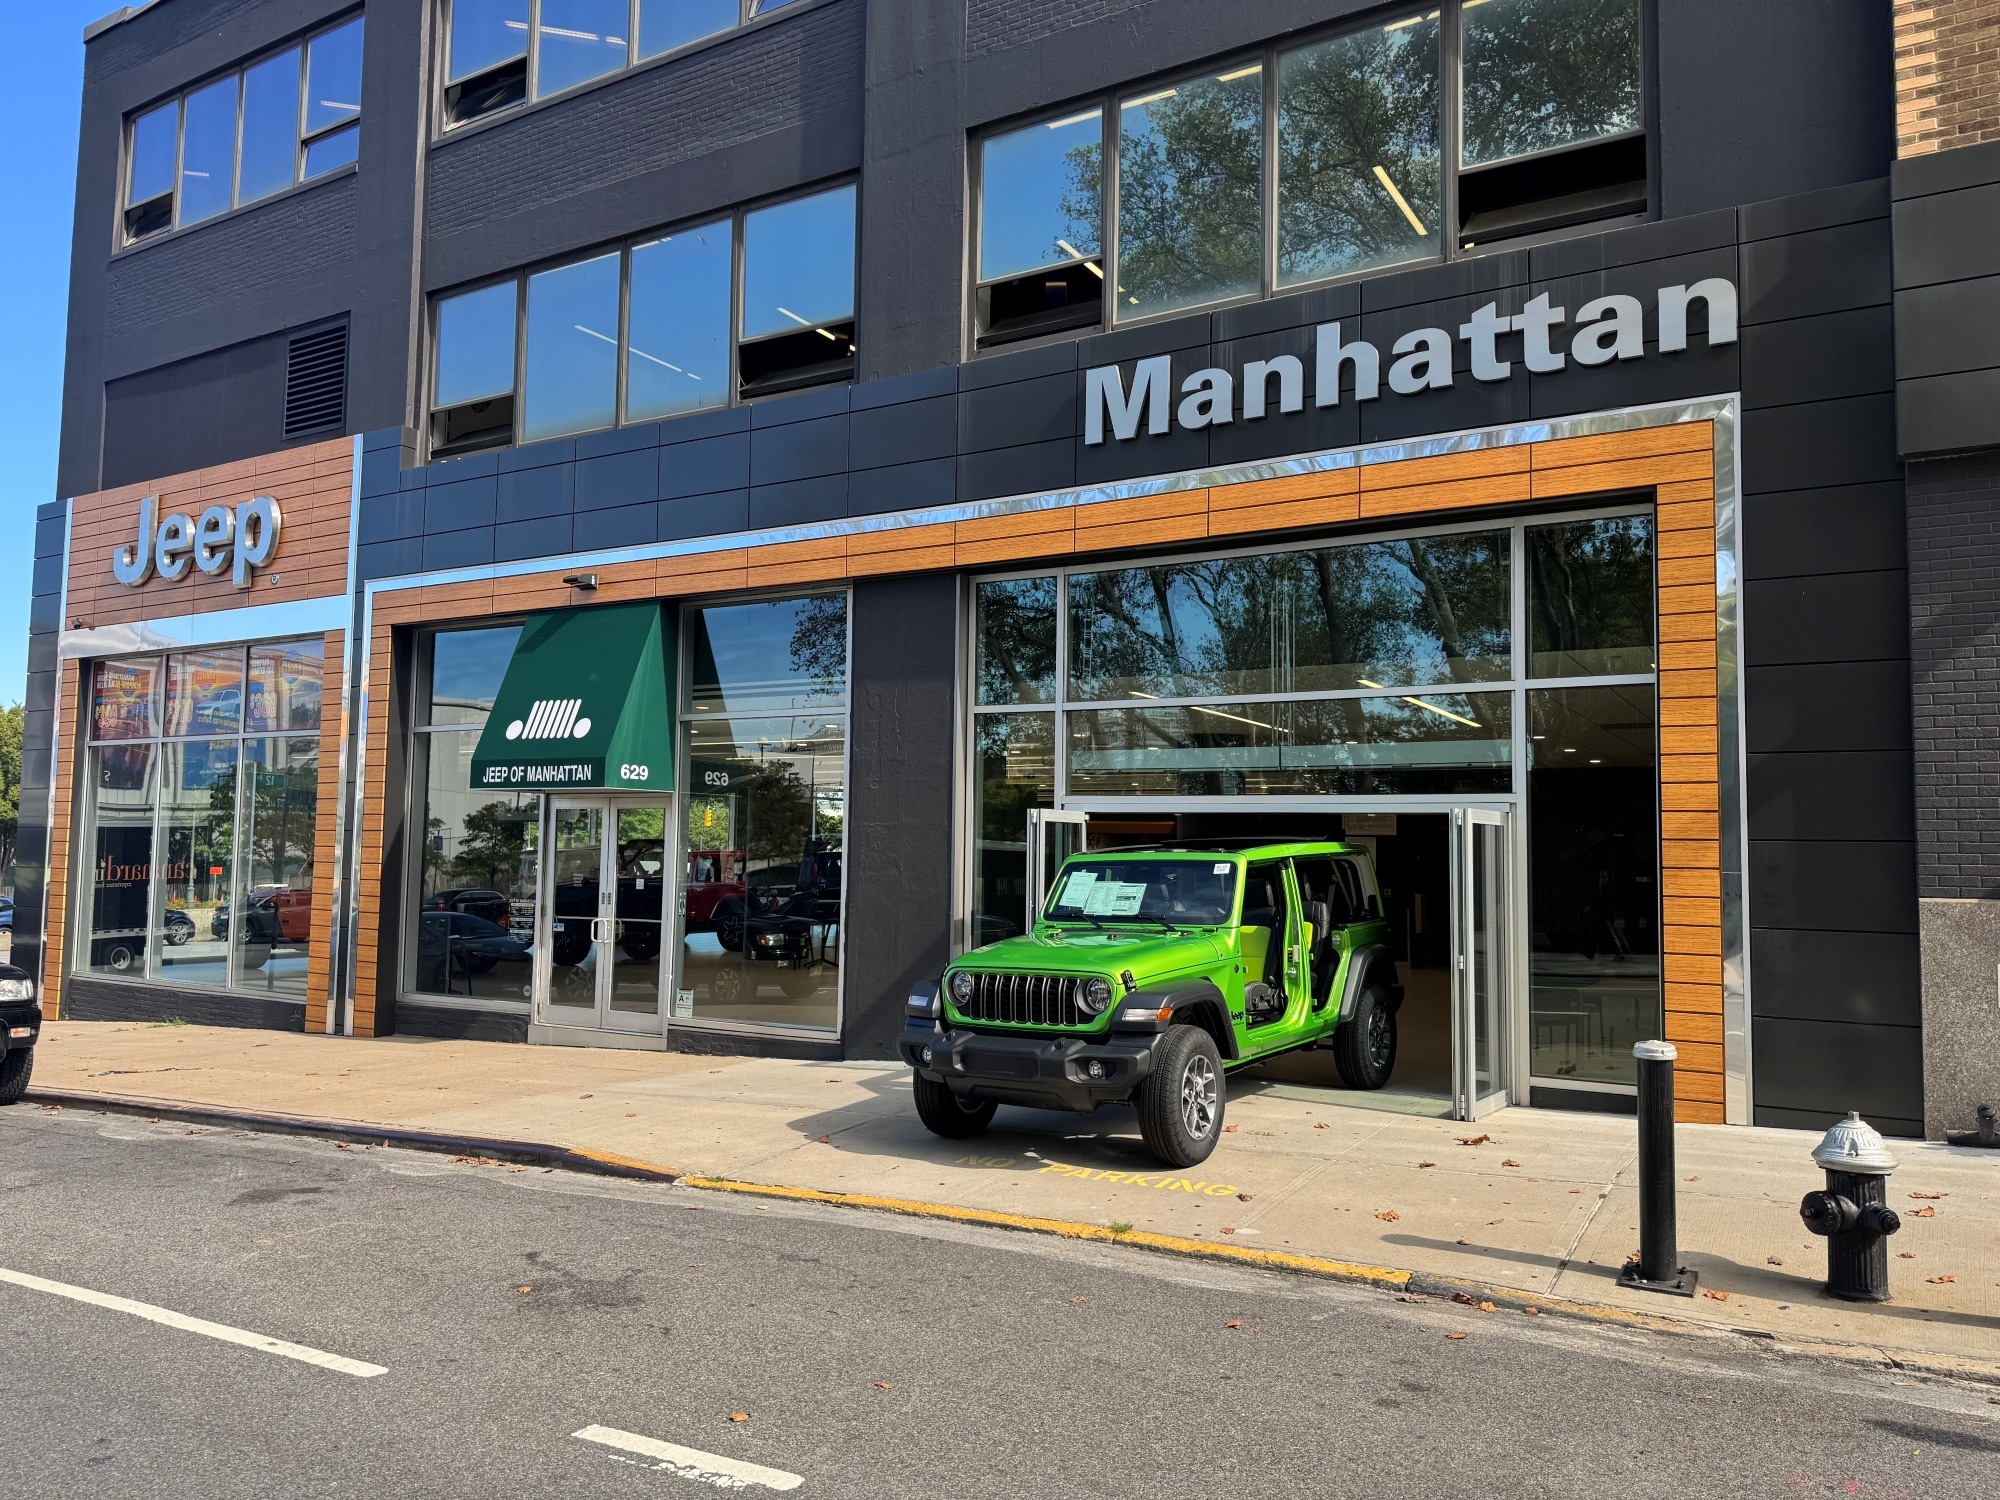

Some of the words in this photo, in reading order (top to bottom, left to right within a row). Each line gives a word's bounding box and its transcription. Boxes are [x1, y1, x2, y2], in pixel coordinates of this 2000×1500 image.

[1084, 277, 1738, 446] Manhattan
[113, 495, 282, 590] Jeep
[483, 767, 508, 783] JEEP
[510, 765, 524, 782] OF
[527, 764, 591, 782] MANHATTAN
[620, 764, 649, 780] 629
[678, 994, 685, 1003] A
[953, 1154, 1016, 1169] NO
[1036, 1162, 1239, 1197] PARKING
